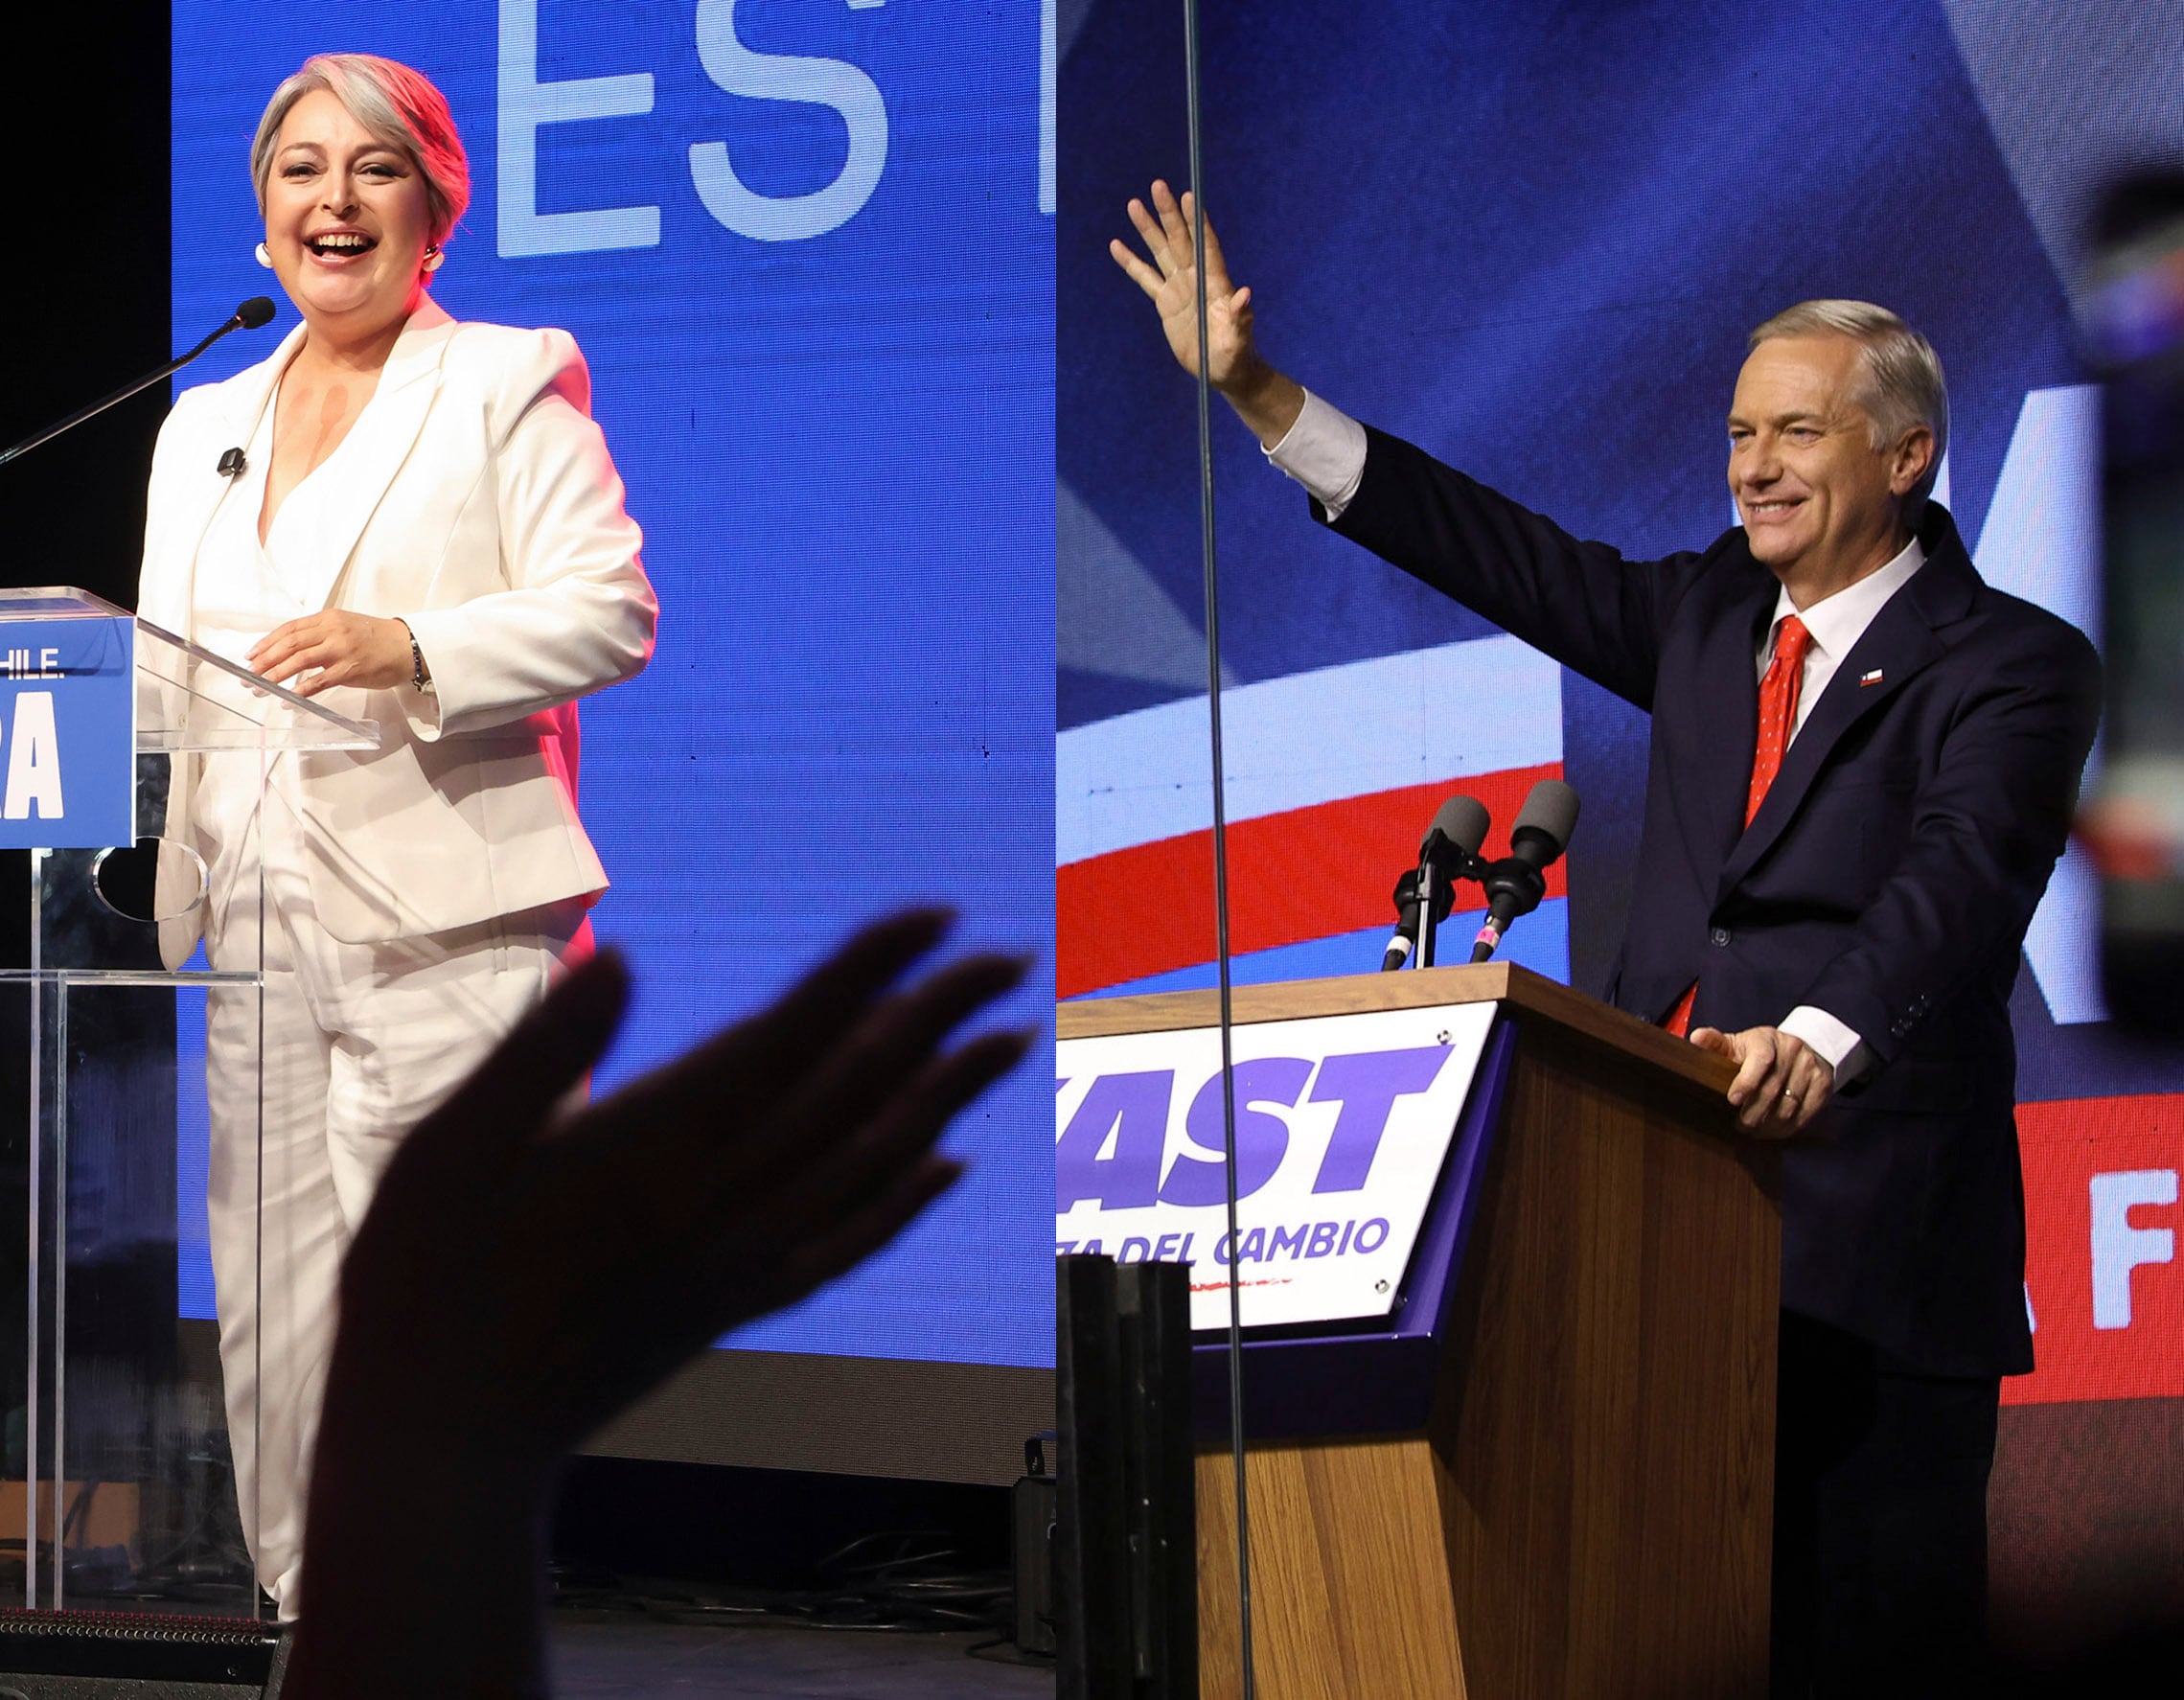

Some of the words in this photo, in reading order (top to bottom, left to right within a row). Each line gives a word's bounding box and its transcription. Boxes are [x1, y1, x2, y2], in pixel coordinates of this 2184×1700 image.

[497, 0, 887, 257] ES
[0, 691, 64, 819] A
[1056, 1045, 1456, 1214] AST
[1213, 1217, 1391, 1265] CAMBIO
[2089, 1169, 2179, 1330] F
